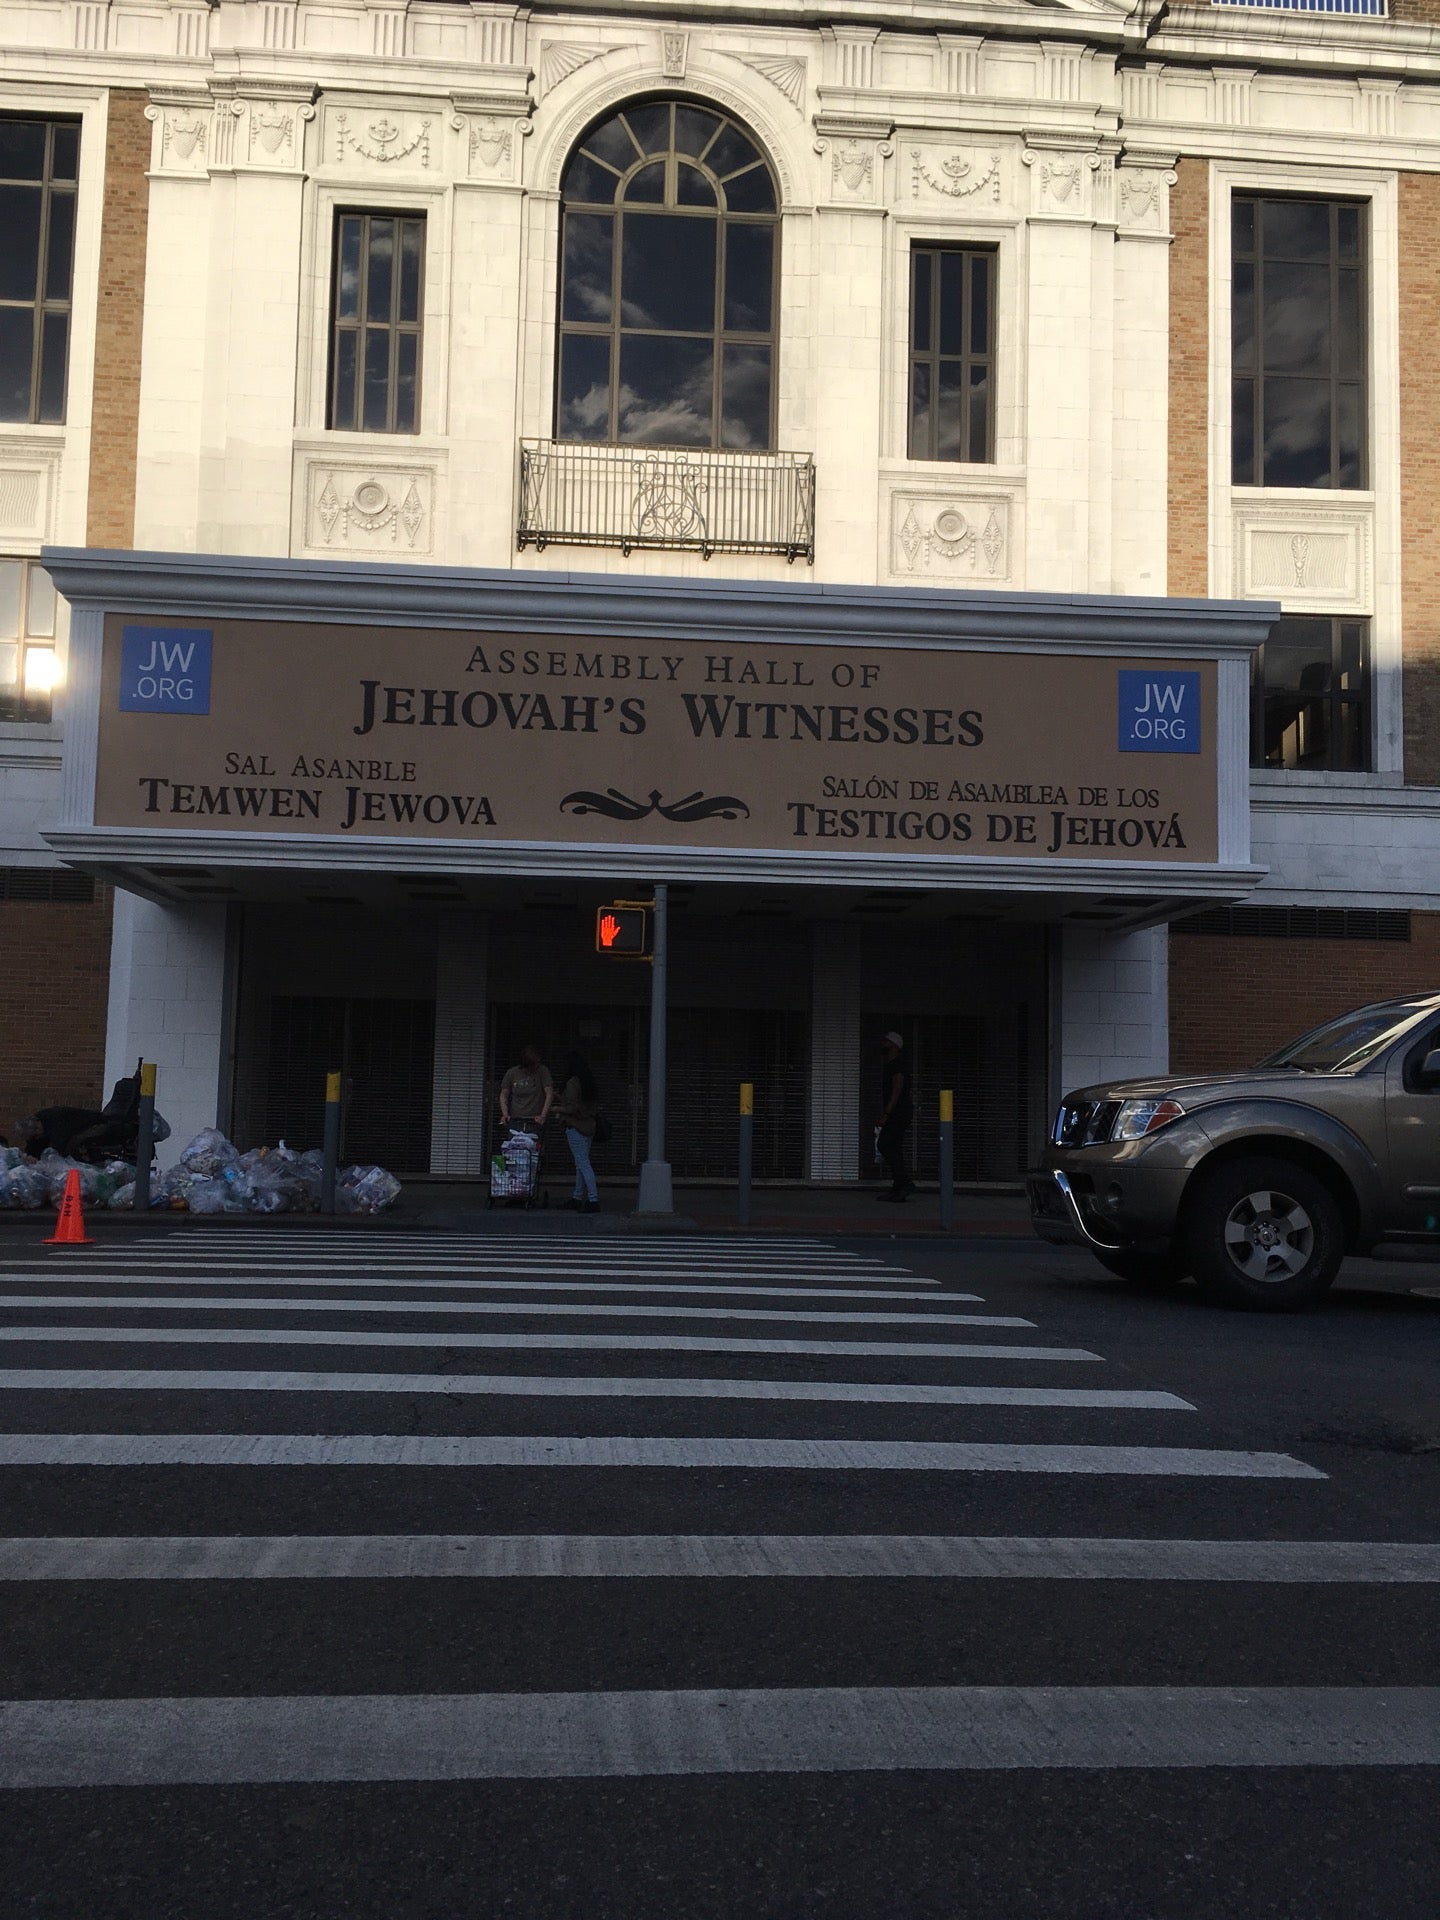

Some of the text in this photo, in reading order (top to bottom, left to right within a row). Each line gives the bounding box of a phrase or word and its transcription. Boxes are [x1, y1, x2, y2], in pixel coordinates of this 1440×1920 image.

[138, 640, 196, 673] JW
[465, 645, 881, 688] ASSEMBLY HALL OF
[131, 676, 193, 701] .ORG
[1134, 683, 1186, 714] JW
[681, 693, 984, 747] WITNESSES
[1130, 718, 1186, 740] .ORG
[225, 752, 417, 782] SAL ASANBLE
[138, 777, 498, 830] TEMWEN JEWOVA
[822, 774, 1160, 809] SALÓN DE ASAMBLEA DE LOS
[787, 802, 1187, 853] TESTIGOS DE JEHOVÁ
